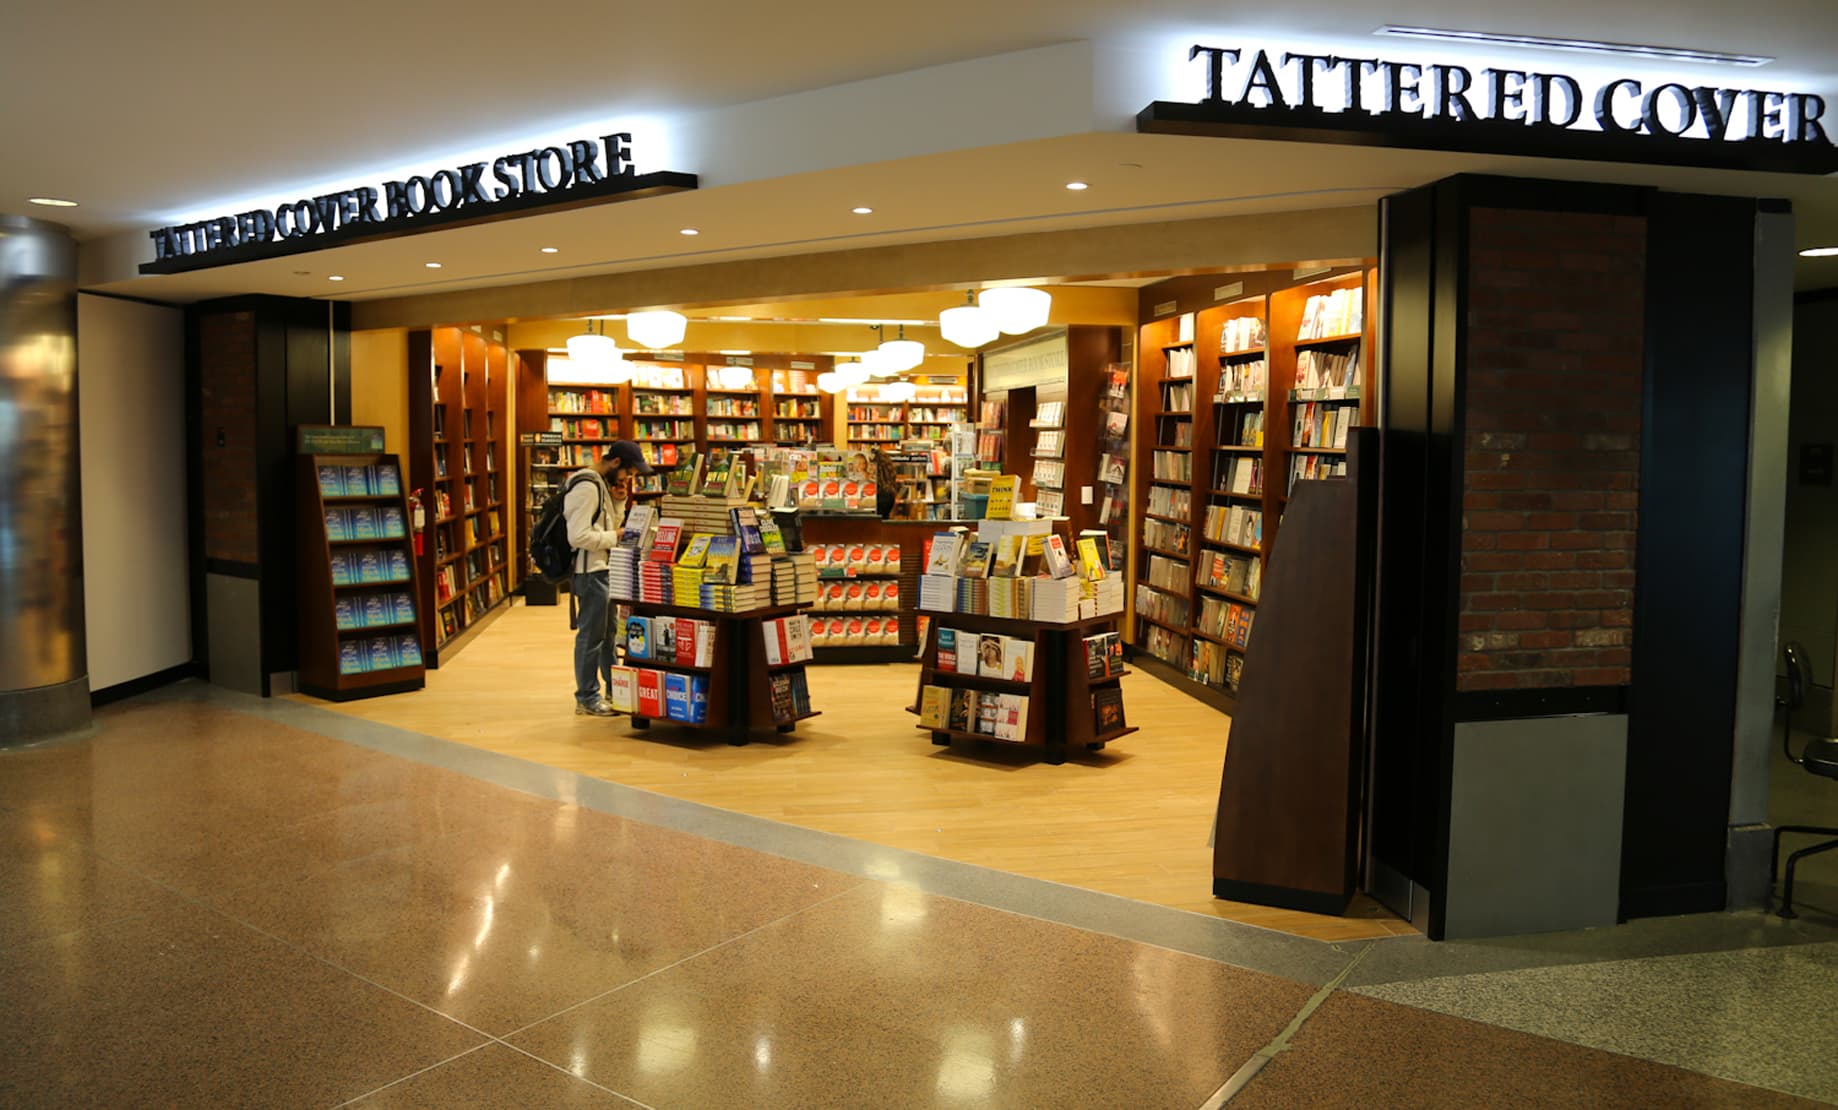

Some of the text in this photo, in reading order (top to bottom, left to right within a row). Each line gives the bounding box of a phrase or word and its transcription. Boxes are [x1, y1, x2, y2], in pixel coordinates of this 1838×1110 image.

[1188, 44, 1833, 146] TATTERED COVER
[149, 209, 275, 260] TATTERED
[276, 186, 383, 239] COVER
[639, 686, 659, 700] GREAT
